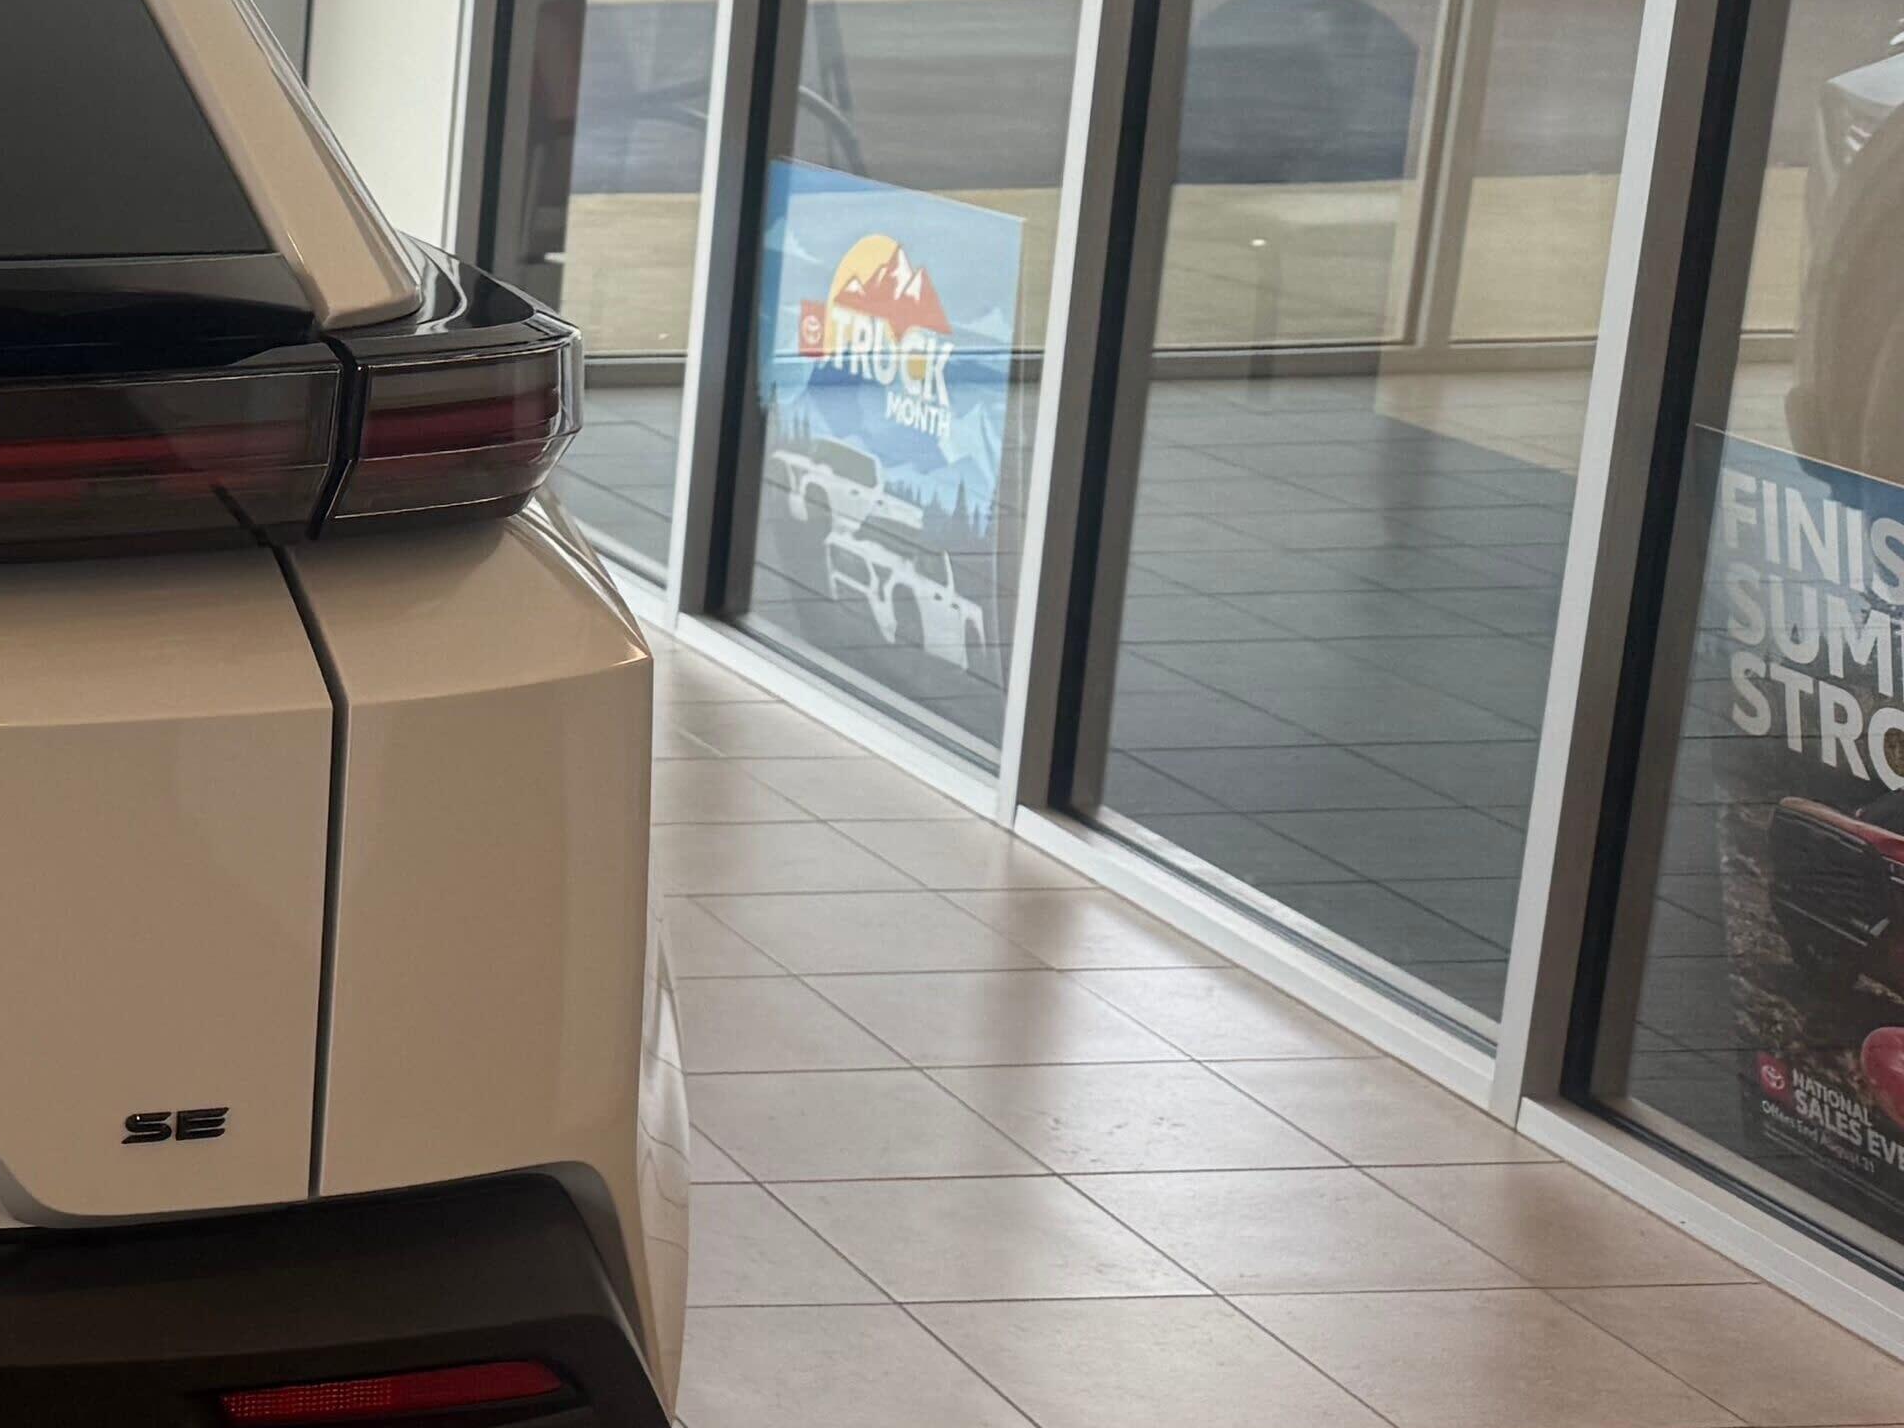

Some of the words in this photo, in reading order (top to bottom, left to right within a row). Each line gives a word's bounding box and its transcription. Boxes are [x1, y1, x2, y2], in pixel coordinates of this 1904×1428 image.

[830, 305, 955, 410] TRUCK
[886, 390, 953, 437] MONTH
[1727, 562, 1904, 697] SUM
[121, 1107, 229, 1144] SE
[1793, 1069, 1873, 1128] NATIONAL
[1795, 1088, 1863, 1147] SALES
